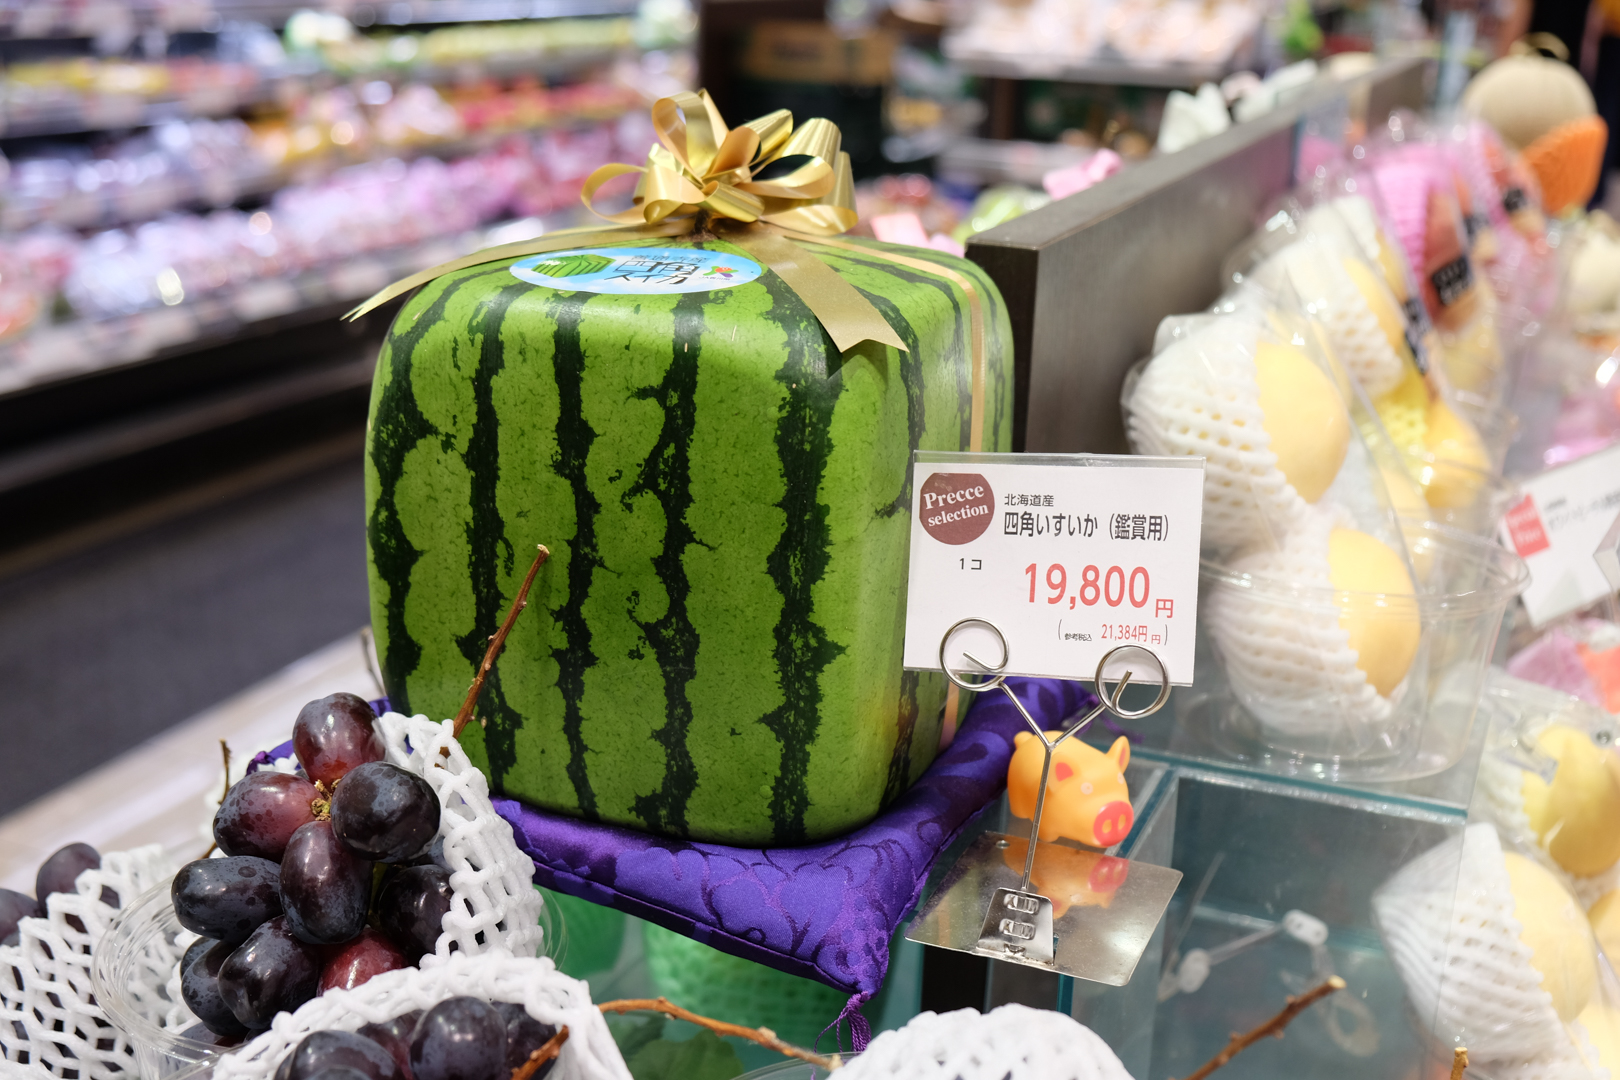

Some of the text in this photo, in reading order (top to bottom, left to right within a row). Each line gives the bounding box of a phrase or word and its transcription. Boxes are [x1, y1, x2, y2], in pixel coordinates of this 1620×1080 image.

[604, 272, 689, 285] スイカ
[923, 485, 985, 510] Precce
[1004, 494, 1054, 507] 北海道産
[927, 503, 989, 527] selection
